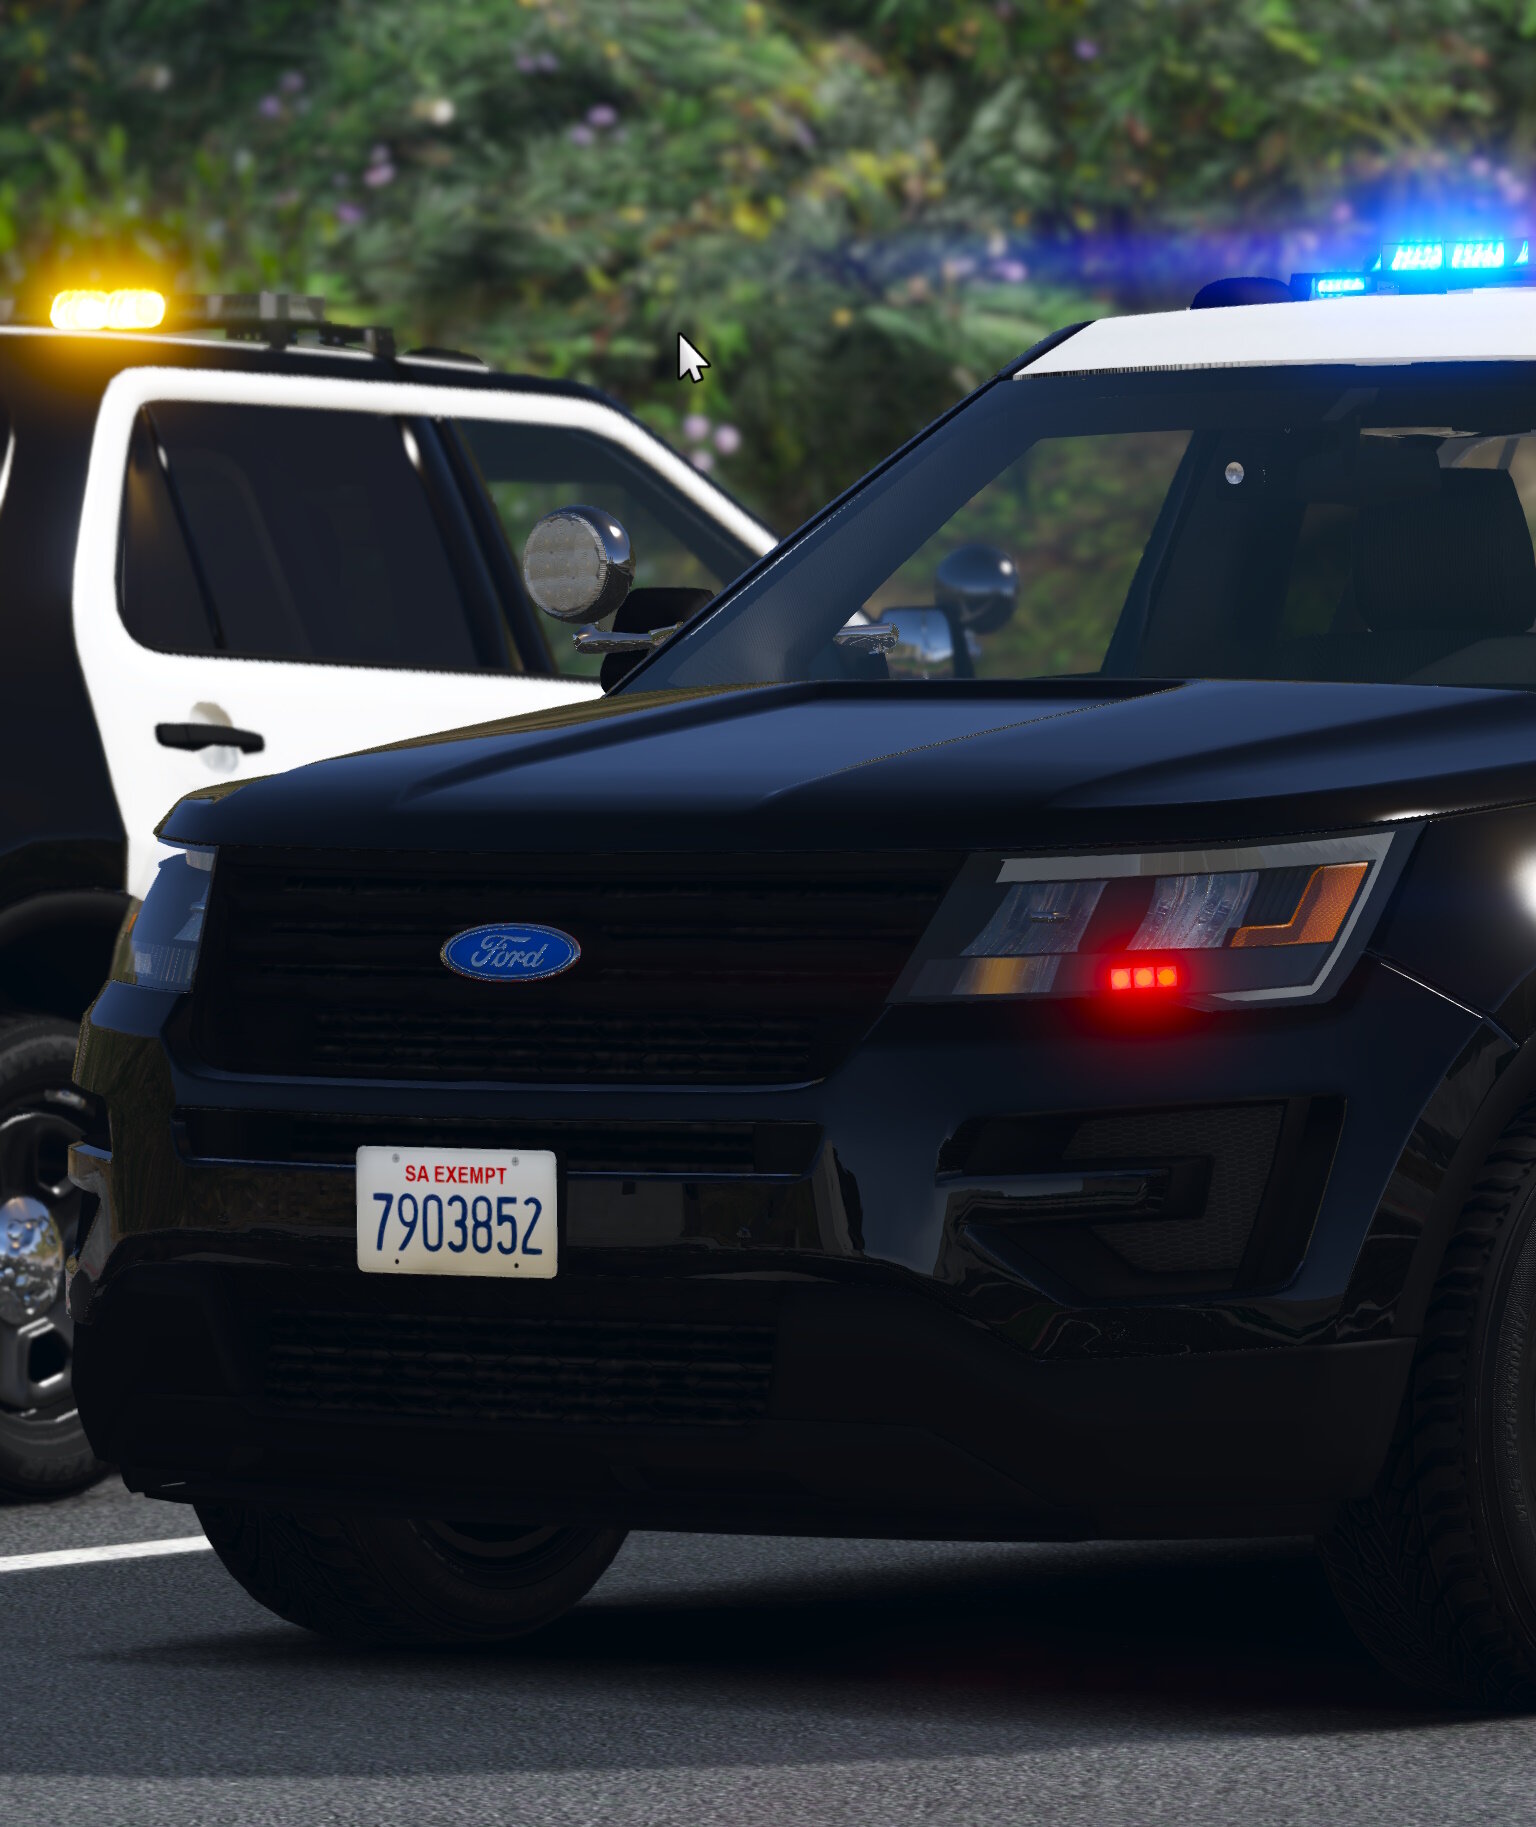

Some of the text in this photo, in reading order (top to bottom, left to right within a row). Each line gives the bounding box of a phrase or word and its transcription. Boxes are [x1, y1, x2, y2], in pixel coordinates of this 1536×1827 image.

[470, 935, 549, 967] Ford
[405, 1165, 507, 1184] SA EXEMPT
[373, 1192, 543, 1255] 7903852
